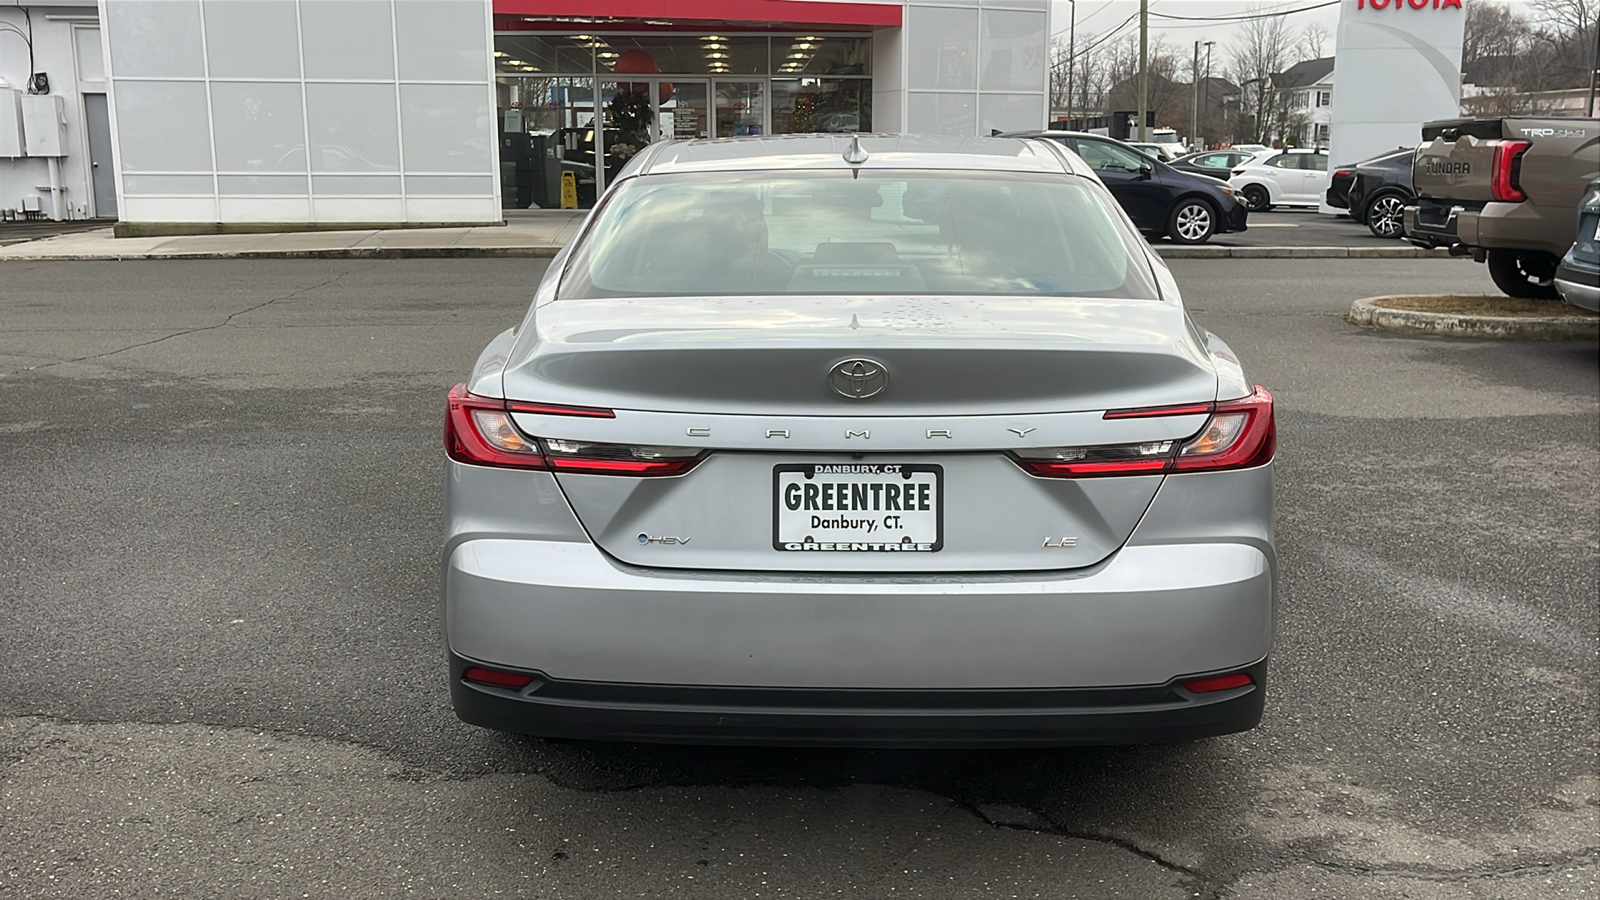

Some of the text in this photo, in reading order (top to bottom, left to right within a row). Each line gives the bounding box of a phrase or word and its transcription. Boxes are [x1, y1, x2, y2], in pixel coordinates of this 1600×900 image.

[1520, 128, 1554, 138] TRD
[1426, 162, 1470, 176] TUNDRA
[686, 426, 1037, 440] CAMRY
[814, 465, 902, 475] DANBURY, CT
[784, 482, 931, 511] GREENTREE
[811, 514, 903, 533] Danbury, CT.
[648, 536, 691, 545] HEV
[784, 542, 932, 551] GREENTREE
[1041, 536, 1079, 548] LE
